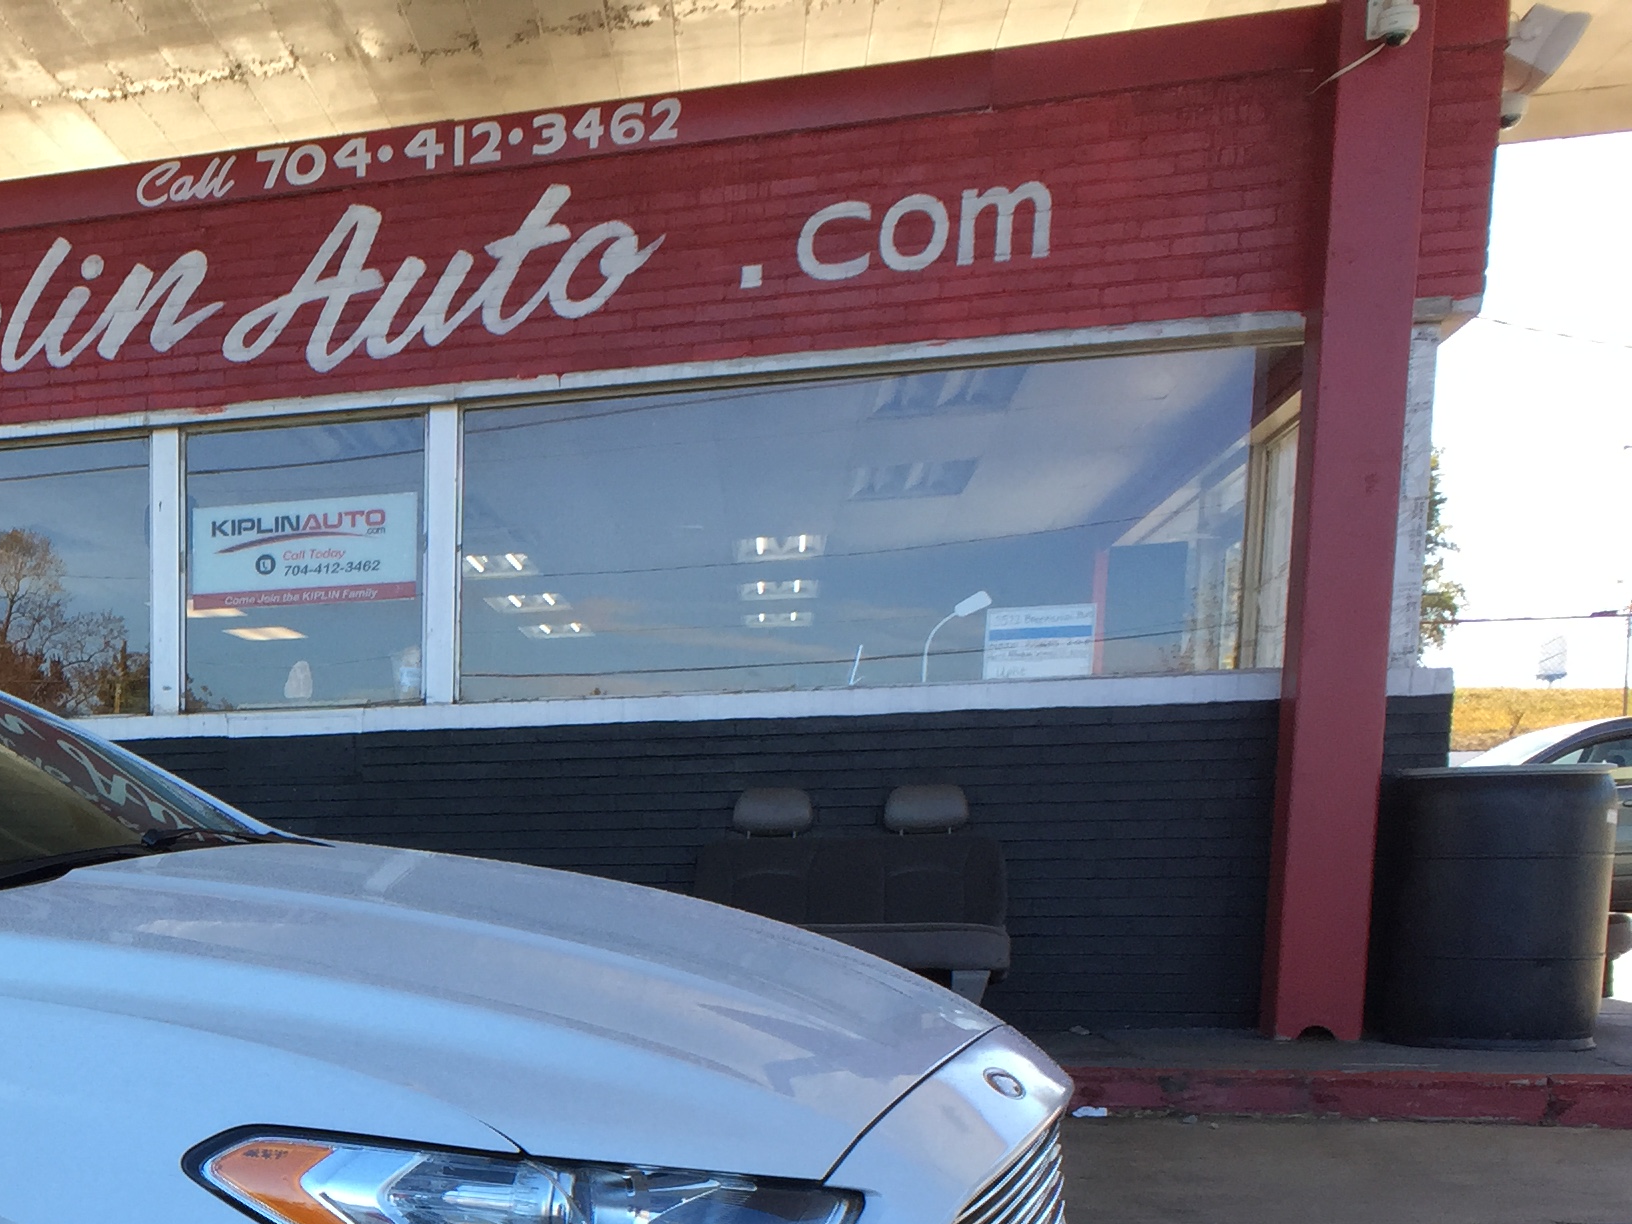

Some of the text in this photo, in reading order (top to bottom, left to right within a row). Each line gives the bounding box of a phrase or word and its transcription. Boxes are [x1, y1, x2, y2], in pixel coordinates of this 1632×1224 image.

[136, 155, 236, 208] Call
[223, 183, 667, 372] Auto
[282, 548, 347, 561] Call Today
[283, 559, 381, 577] 704-412-3462
[224, 587, 378, 605] Come Join the KIPLIN Family
